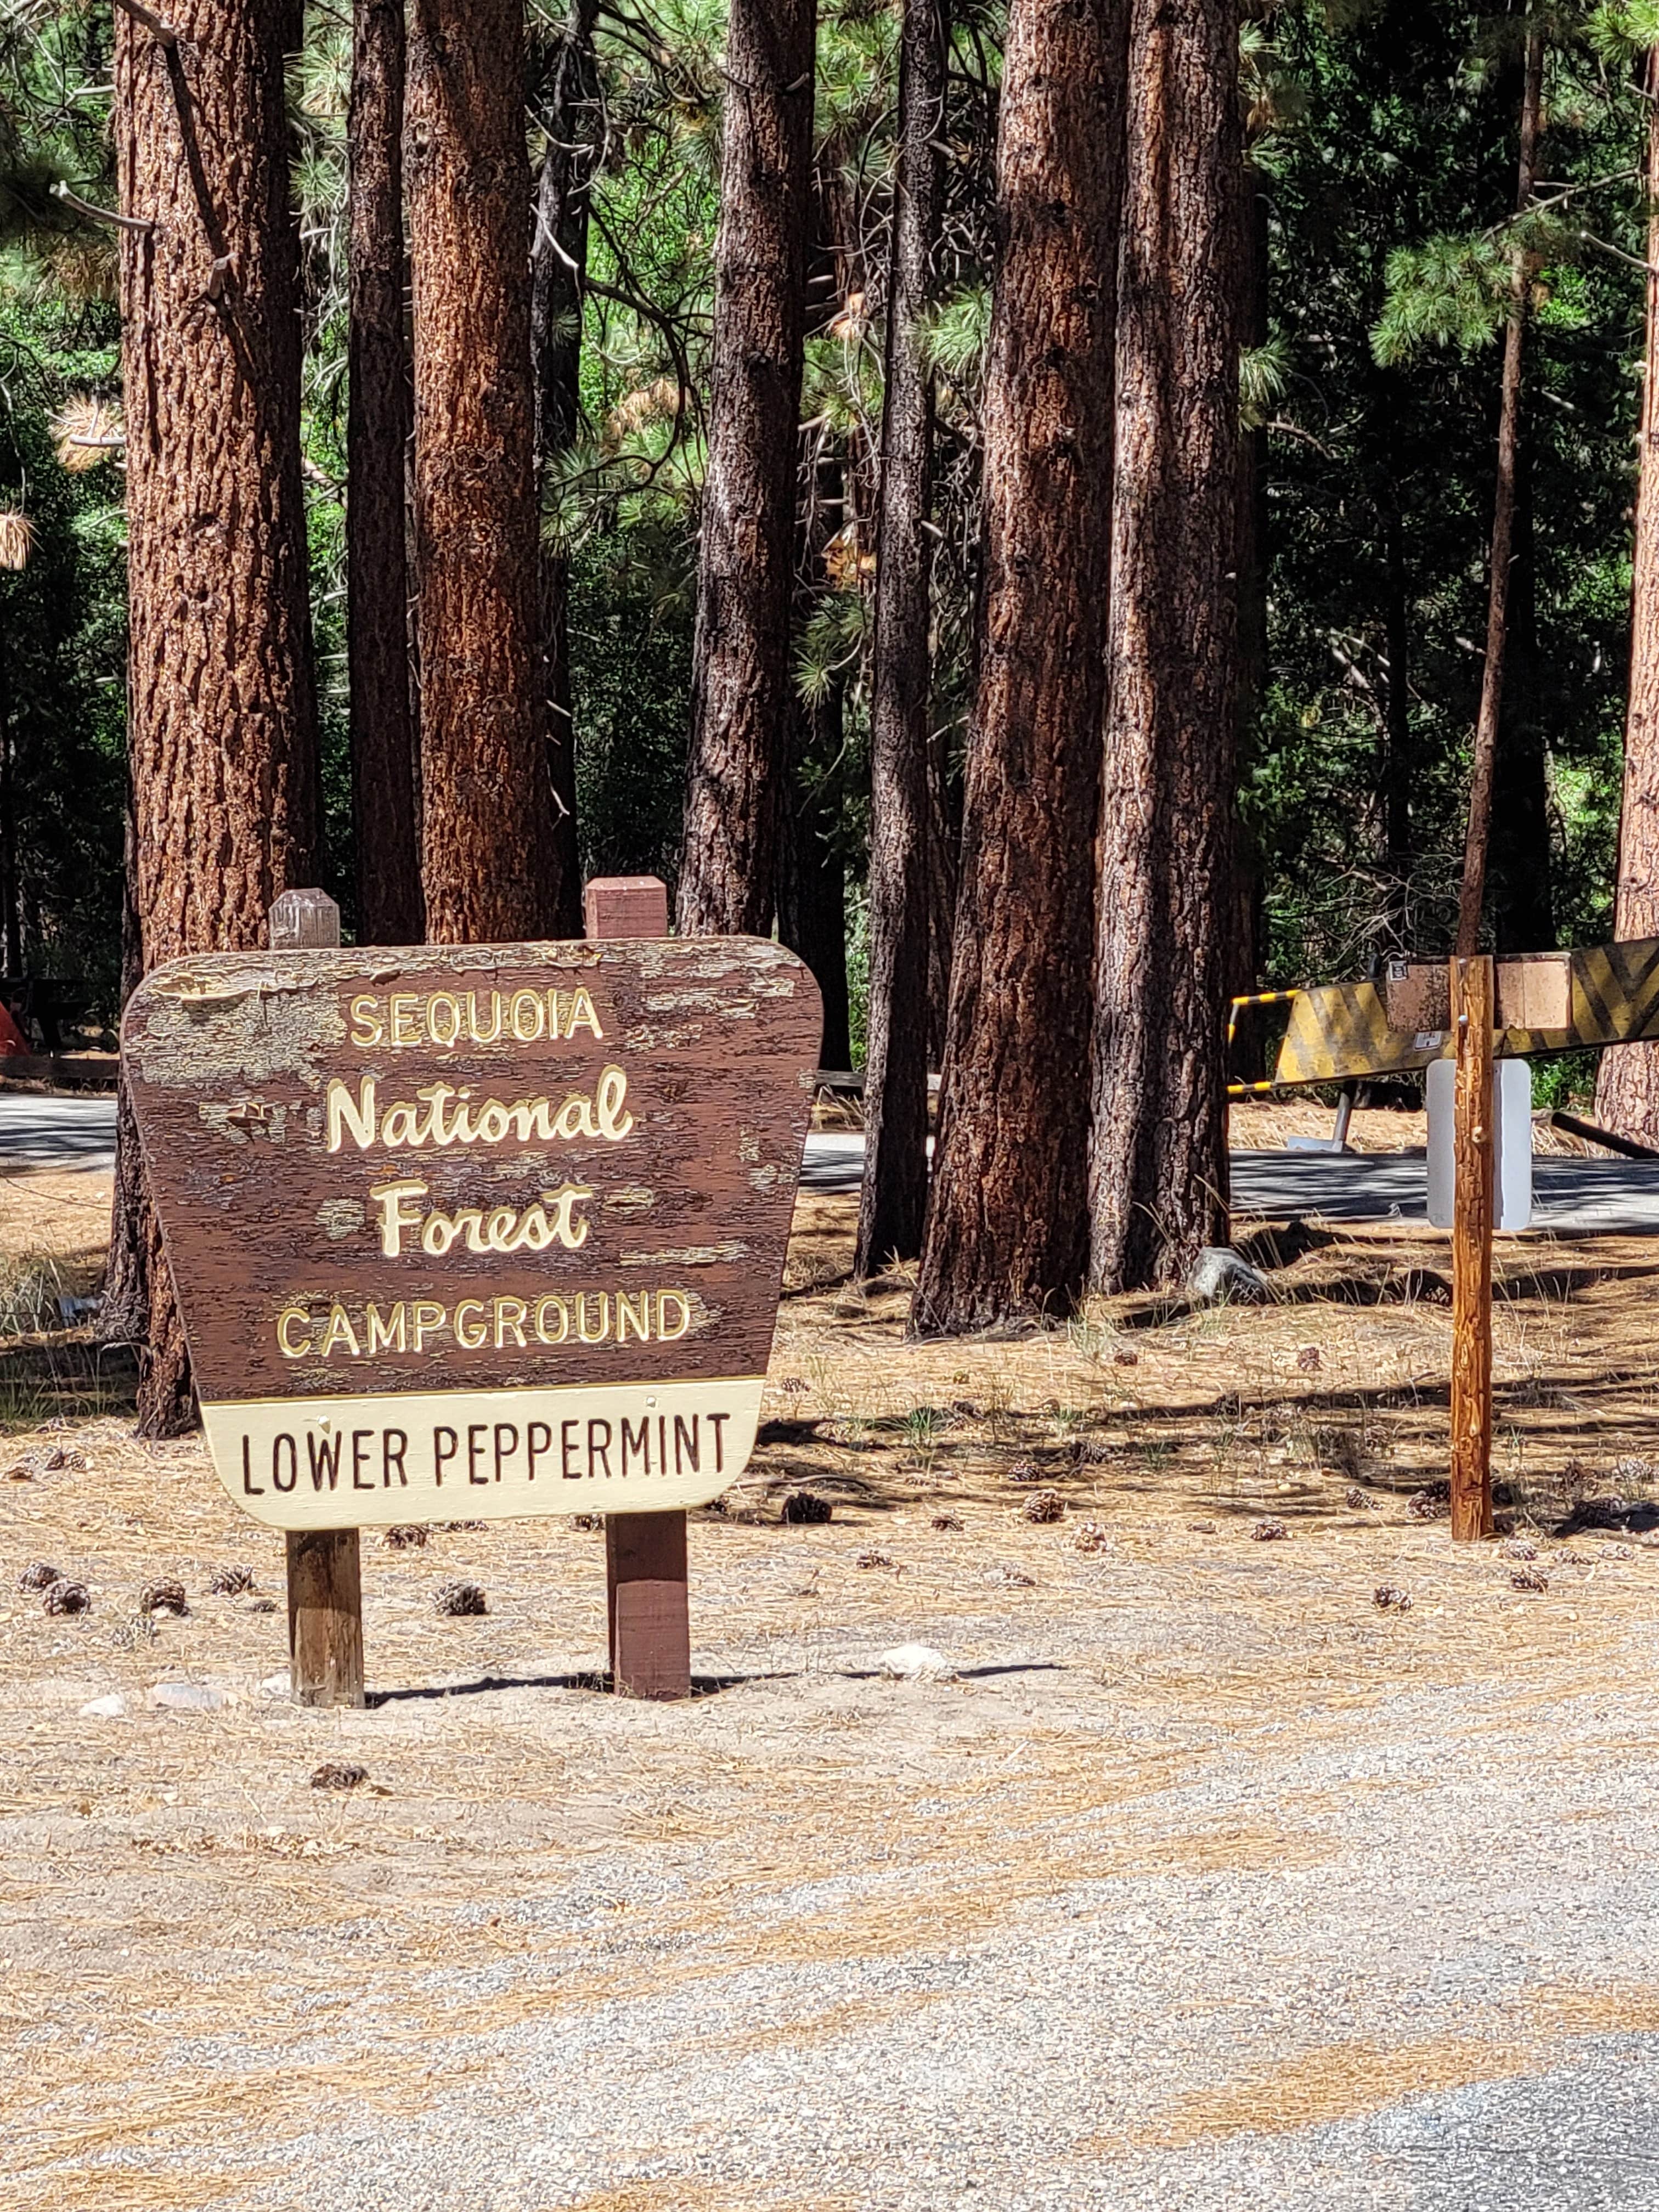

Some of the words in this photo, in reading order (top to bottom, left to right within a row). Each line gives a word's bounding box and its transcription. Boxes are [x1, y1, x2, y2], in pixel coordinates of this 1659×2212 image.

[349, 988, 603, 1048] SEQUOIA
[326, 1064, 634, 1154] National
[369, 1180, 593, 1258] Forest
[276, 1289, 690, 1359] CAMPGROUND
[242, 1427, 409, 1496] LOWER
[433, 1413, 731, 1487] PEPPERMINT
